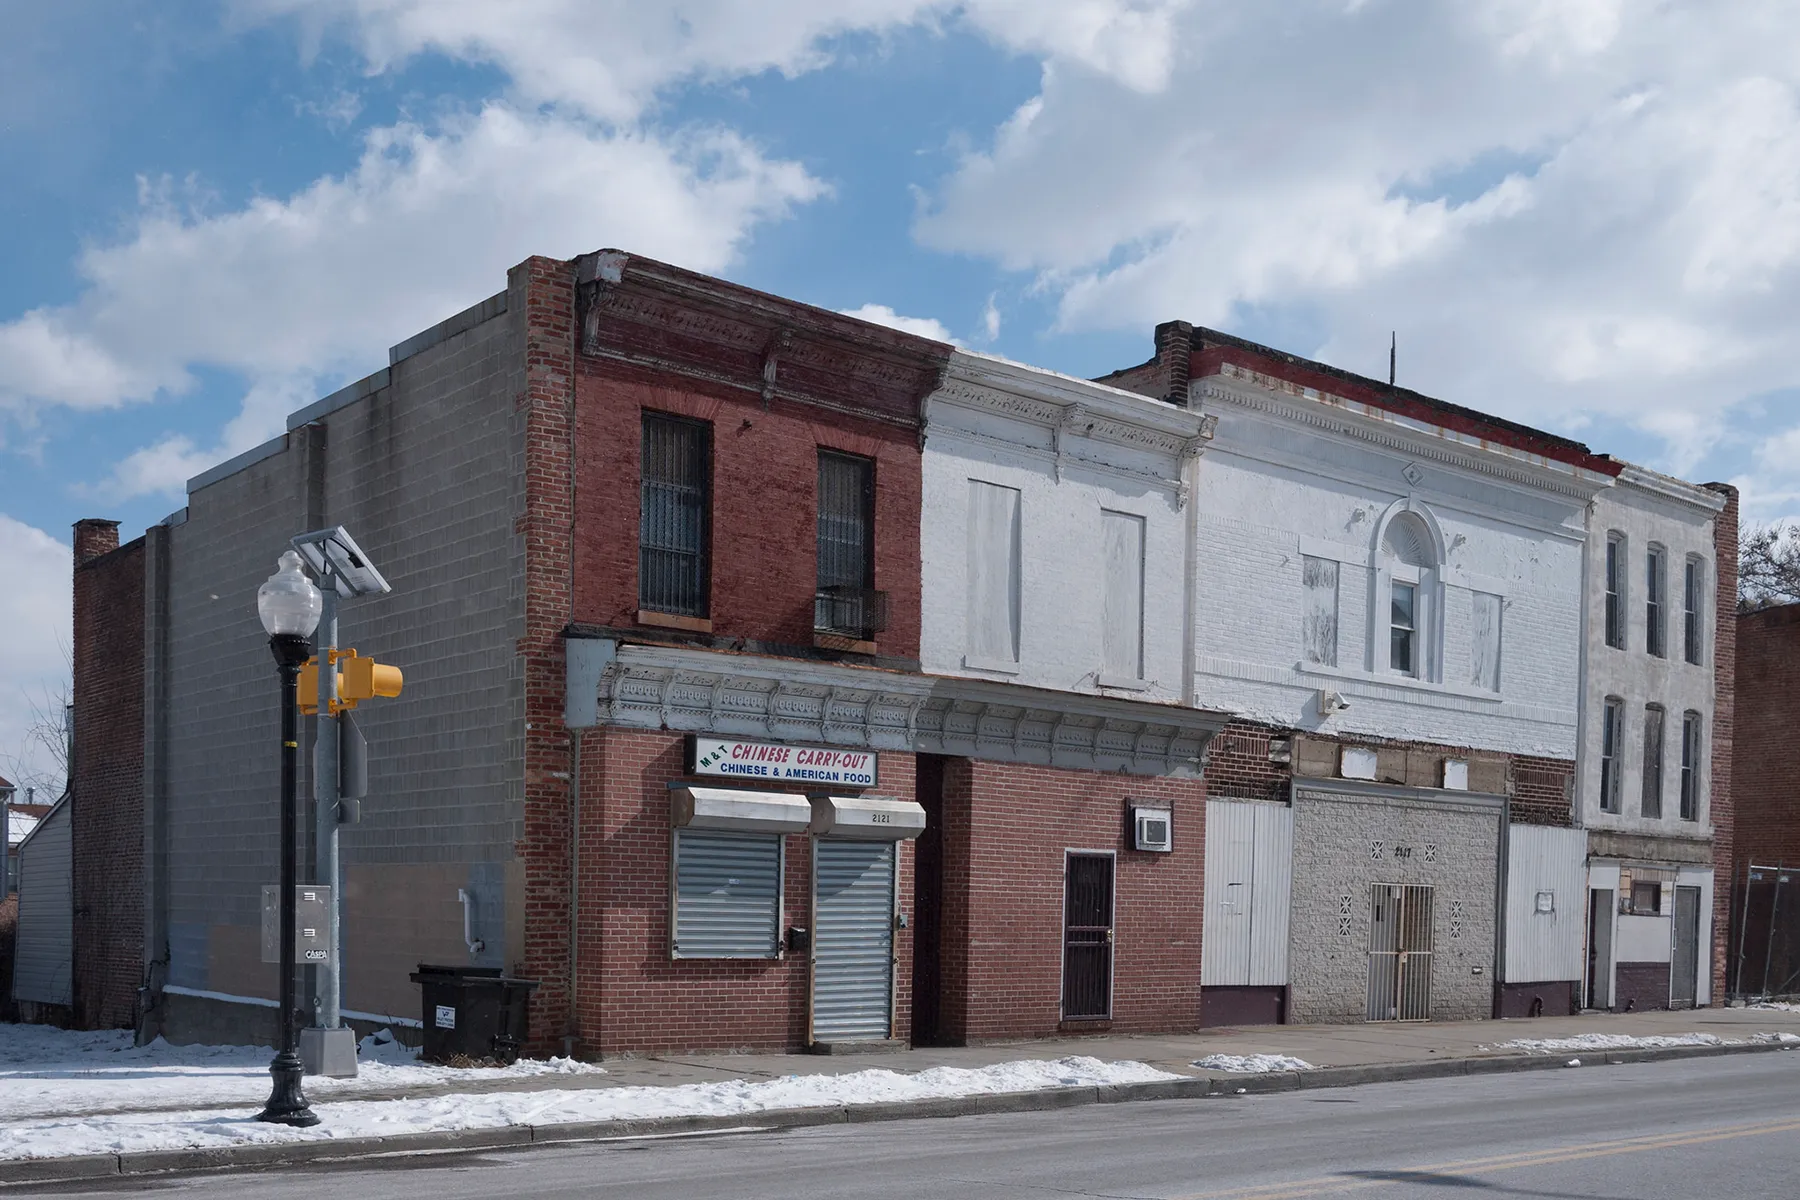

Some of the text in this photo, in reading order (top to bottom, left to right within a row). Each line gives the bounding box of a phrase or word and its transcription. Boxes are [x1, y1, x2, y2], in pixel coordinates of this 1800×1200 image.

[699, 744, 728, 768] M & T
[732, 744, 869, 769] CHINESE CARRY-OUT
[720, 763, 871, 783] CHINESE & AMERICAN FOOD
[872, 813, 890, 823] 2121
